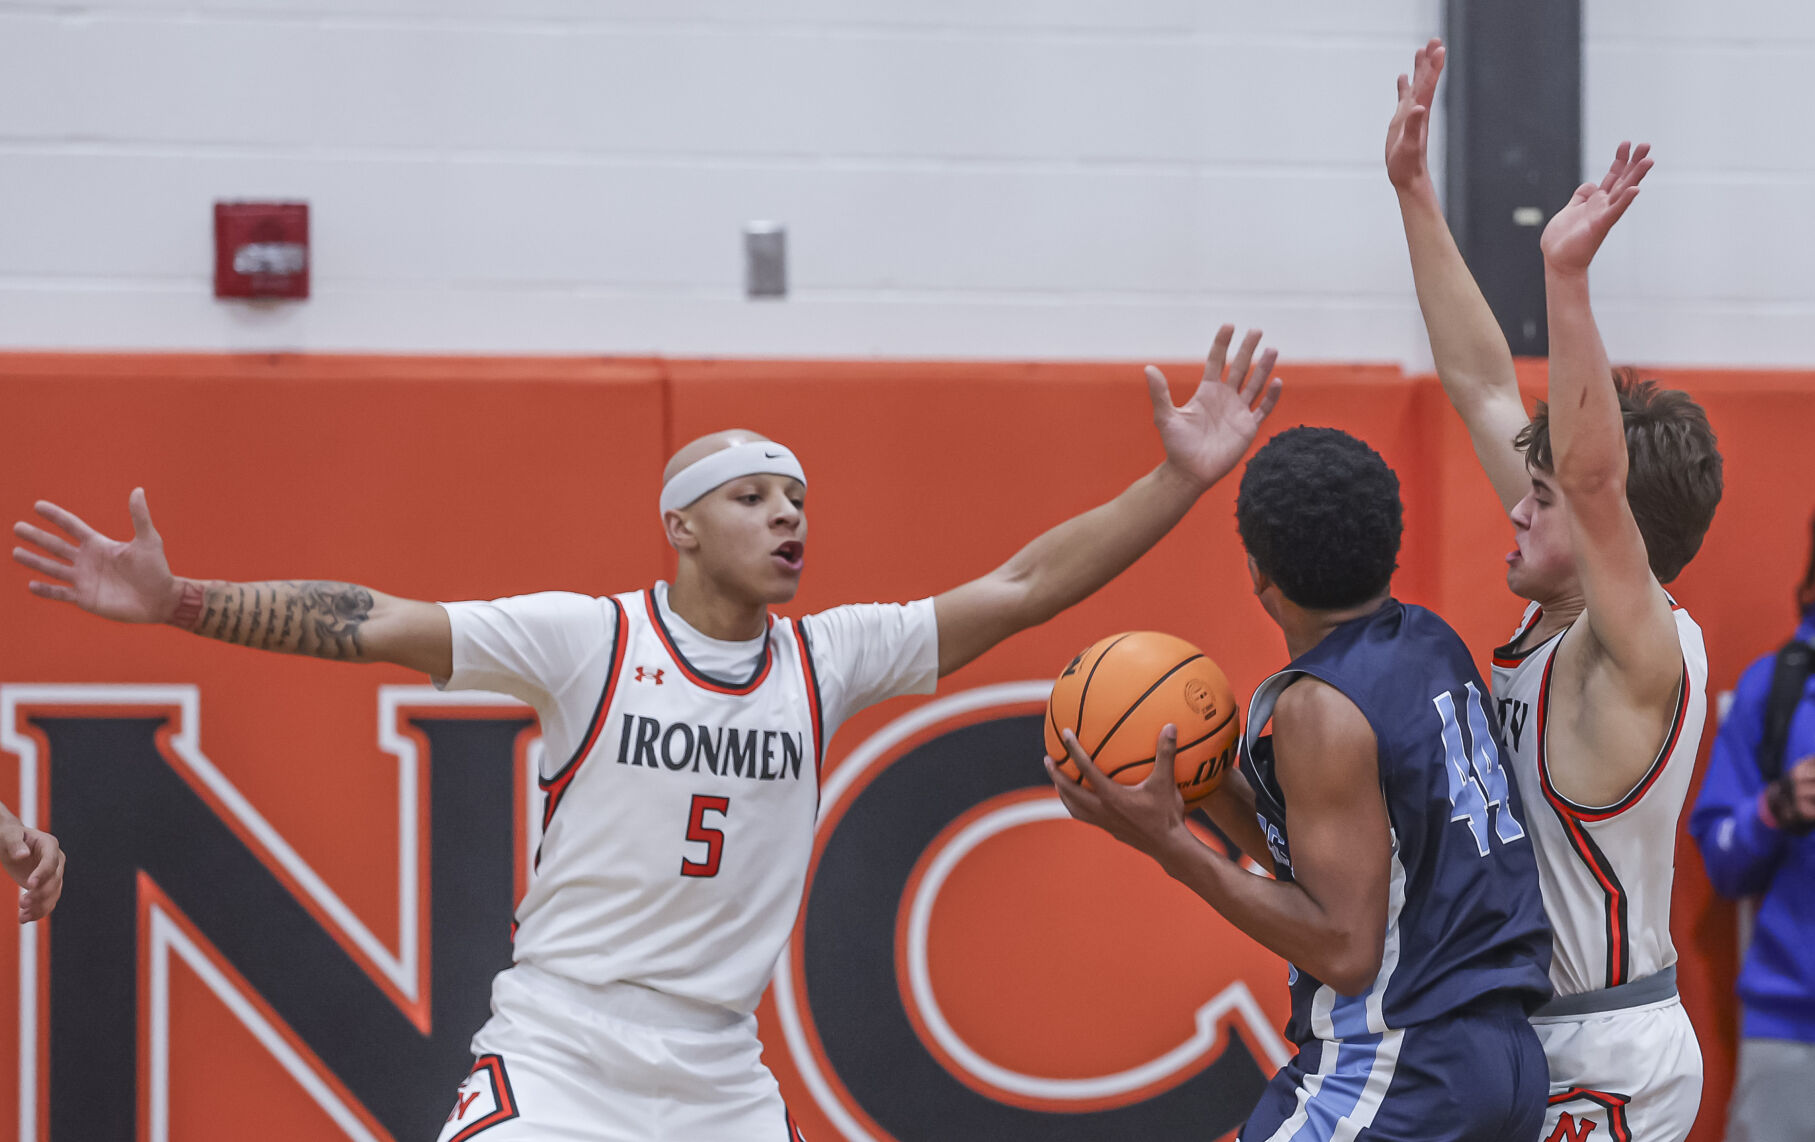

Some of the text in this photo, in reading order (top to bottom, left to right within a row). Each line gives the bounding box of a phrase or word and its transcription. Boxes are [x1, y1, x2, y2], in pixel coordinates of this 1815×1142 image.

[616, 712, 803, 781] IRONMEN
[1432, 680, 1526, 859] 44
[680, 794, 731, 878] 5
[1544, 1111, 1598, 1142] N
